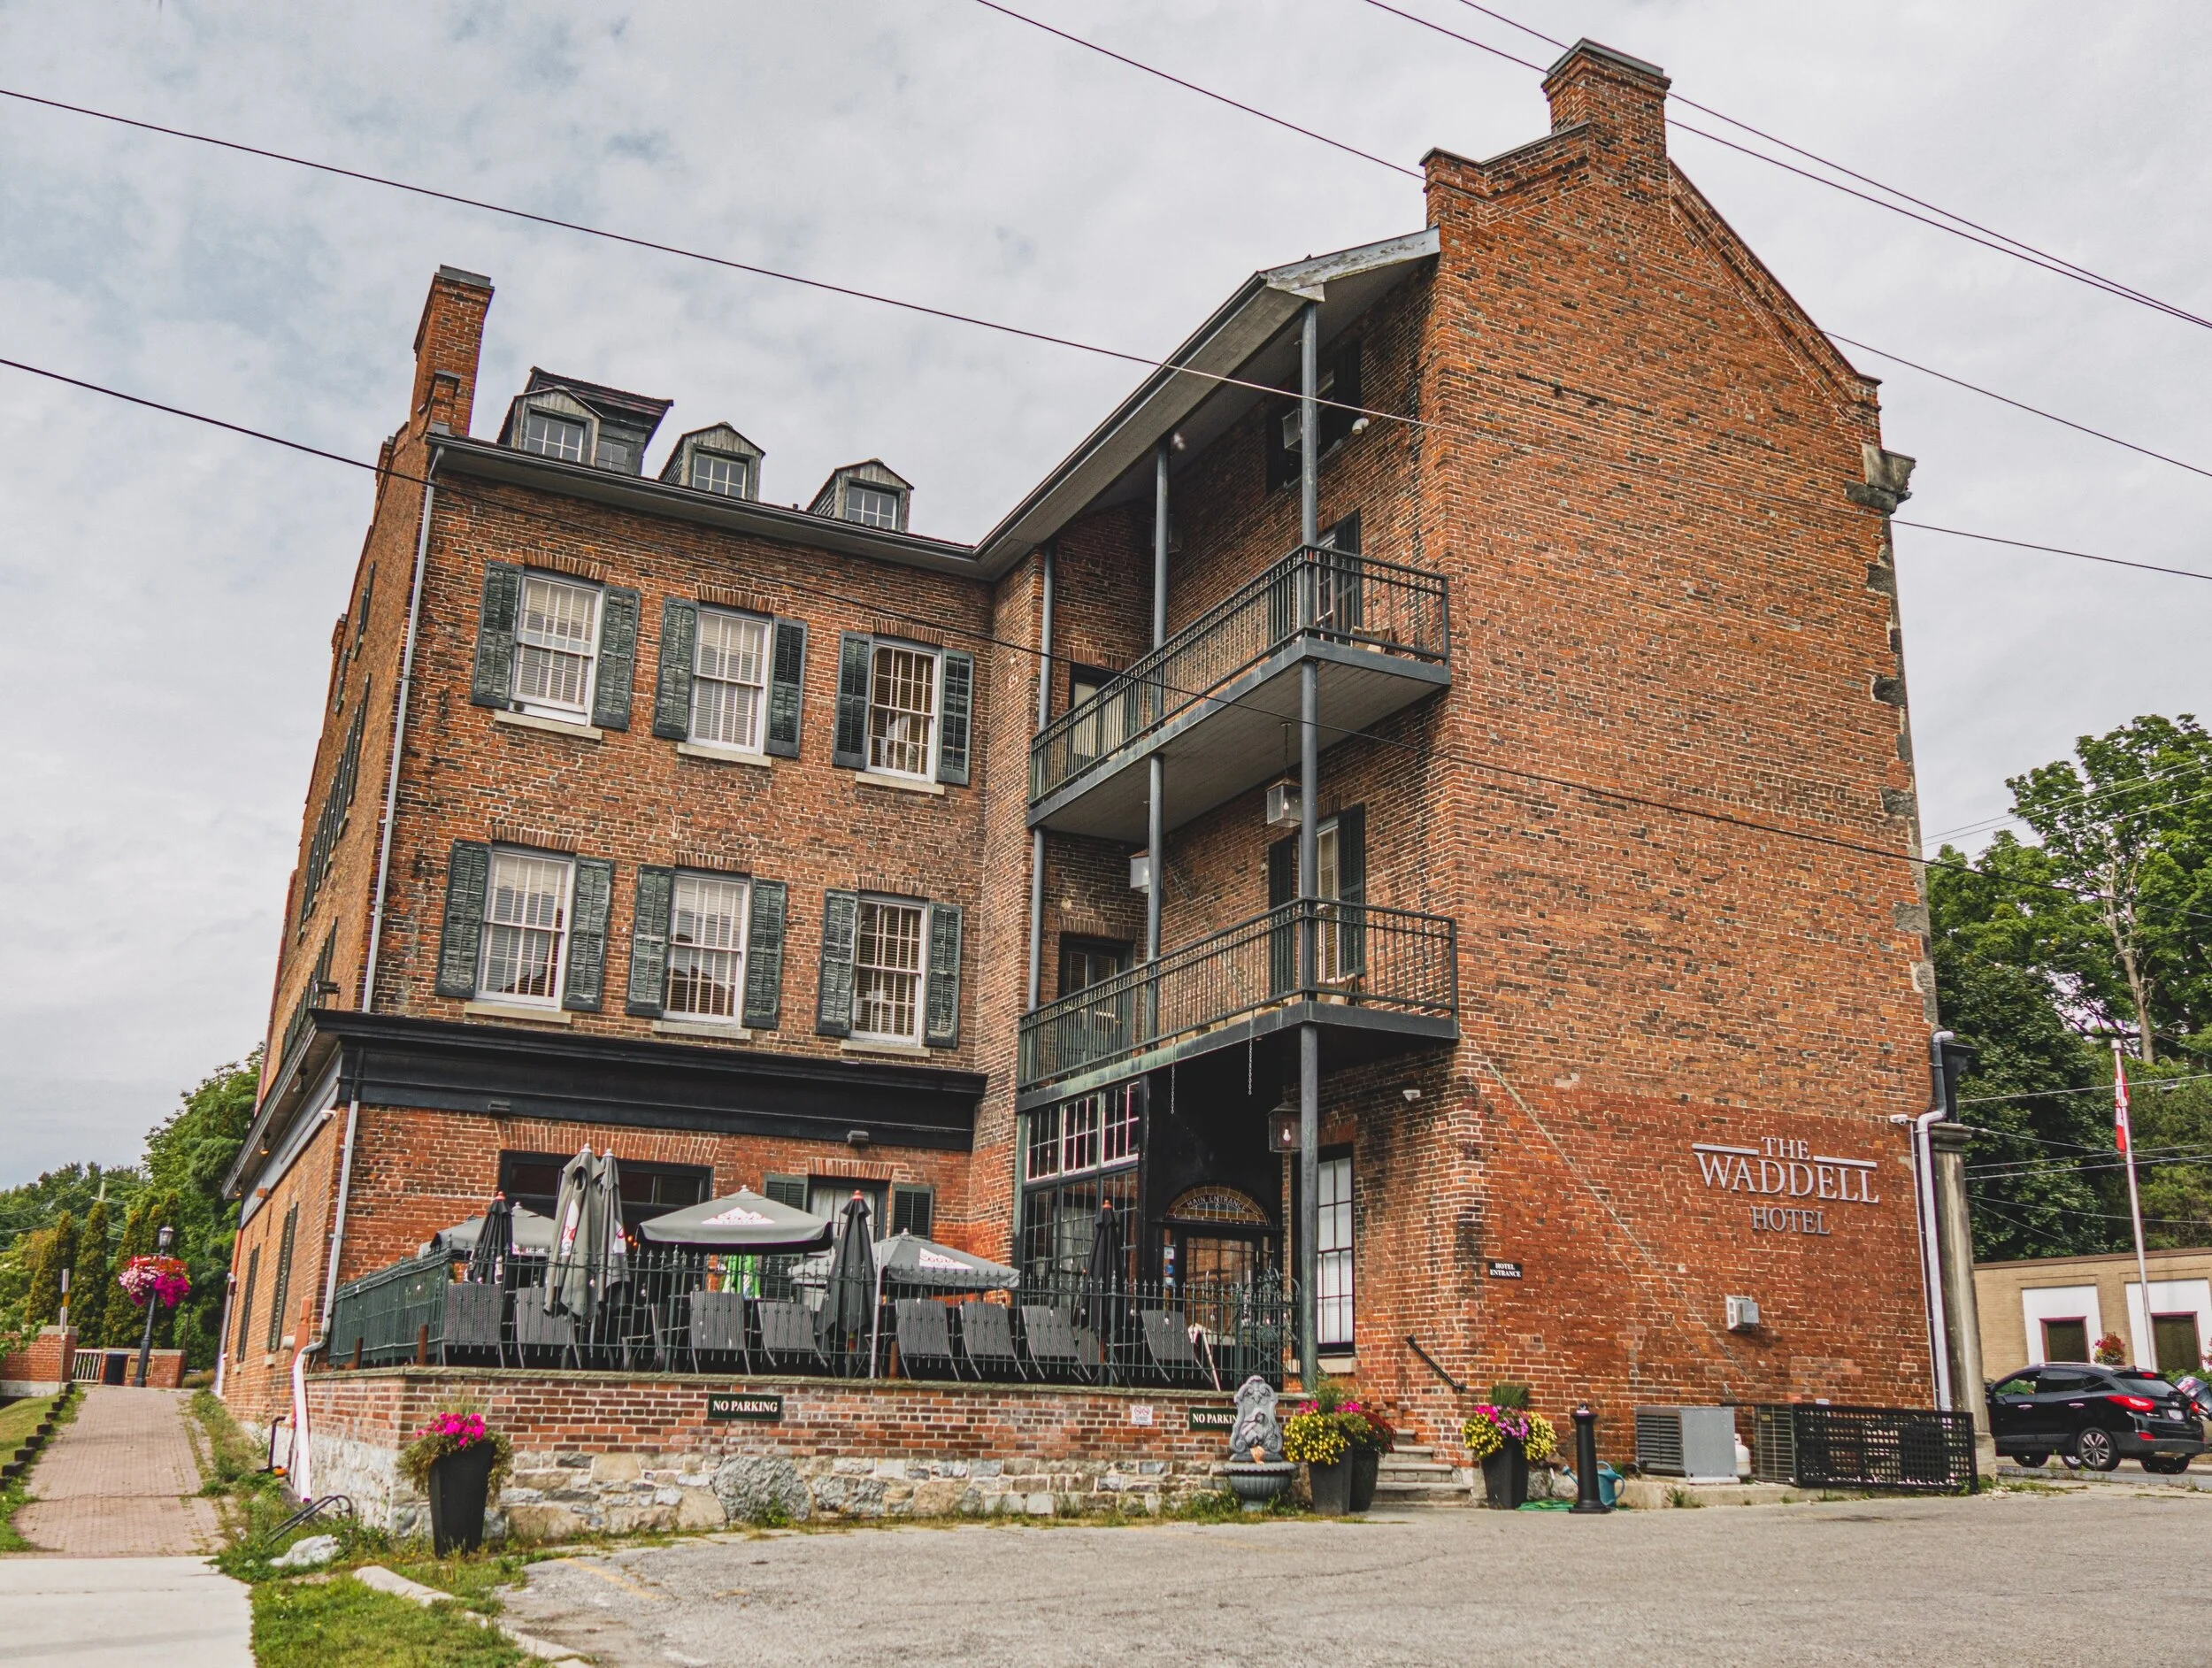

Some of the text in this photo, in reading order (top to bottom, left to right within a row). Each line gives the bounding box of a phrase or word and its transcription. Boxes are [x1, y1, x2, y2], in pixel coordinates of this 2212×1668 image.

[1761, 1136, 1810, 1160] THE
[1694, 1152, 1879, 1203] WADDELL
[1187, 1195, 1246, 1211] MAIN ENTRANCE
[1751, 1205, 1831, 1234] HOTEL
[1490, 1269, 1521, 1278] ENTRANCE
[713, 1400, 778, 1412] NO PARKING
[1192, 1413, 1237, 1424] NO PARKIN
